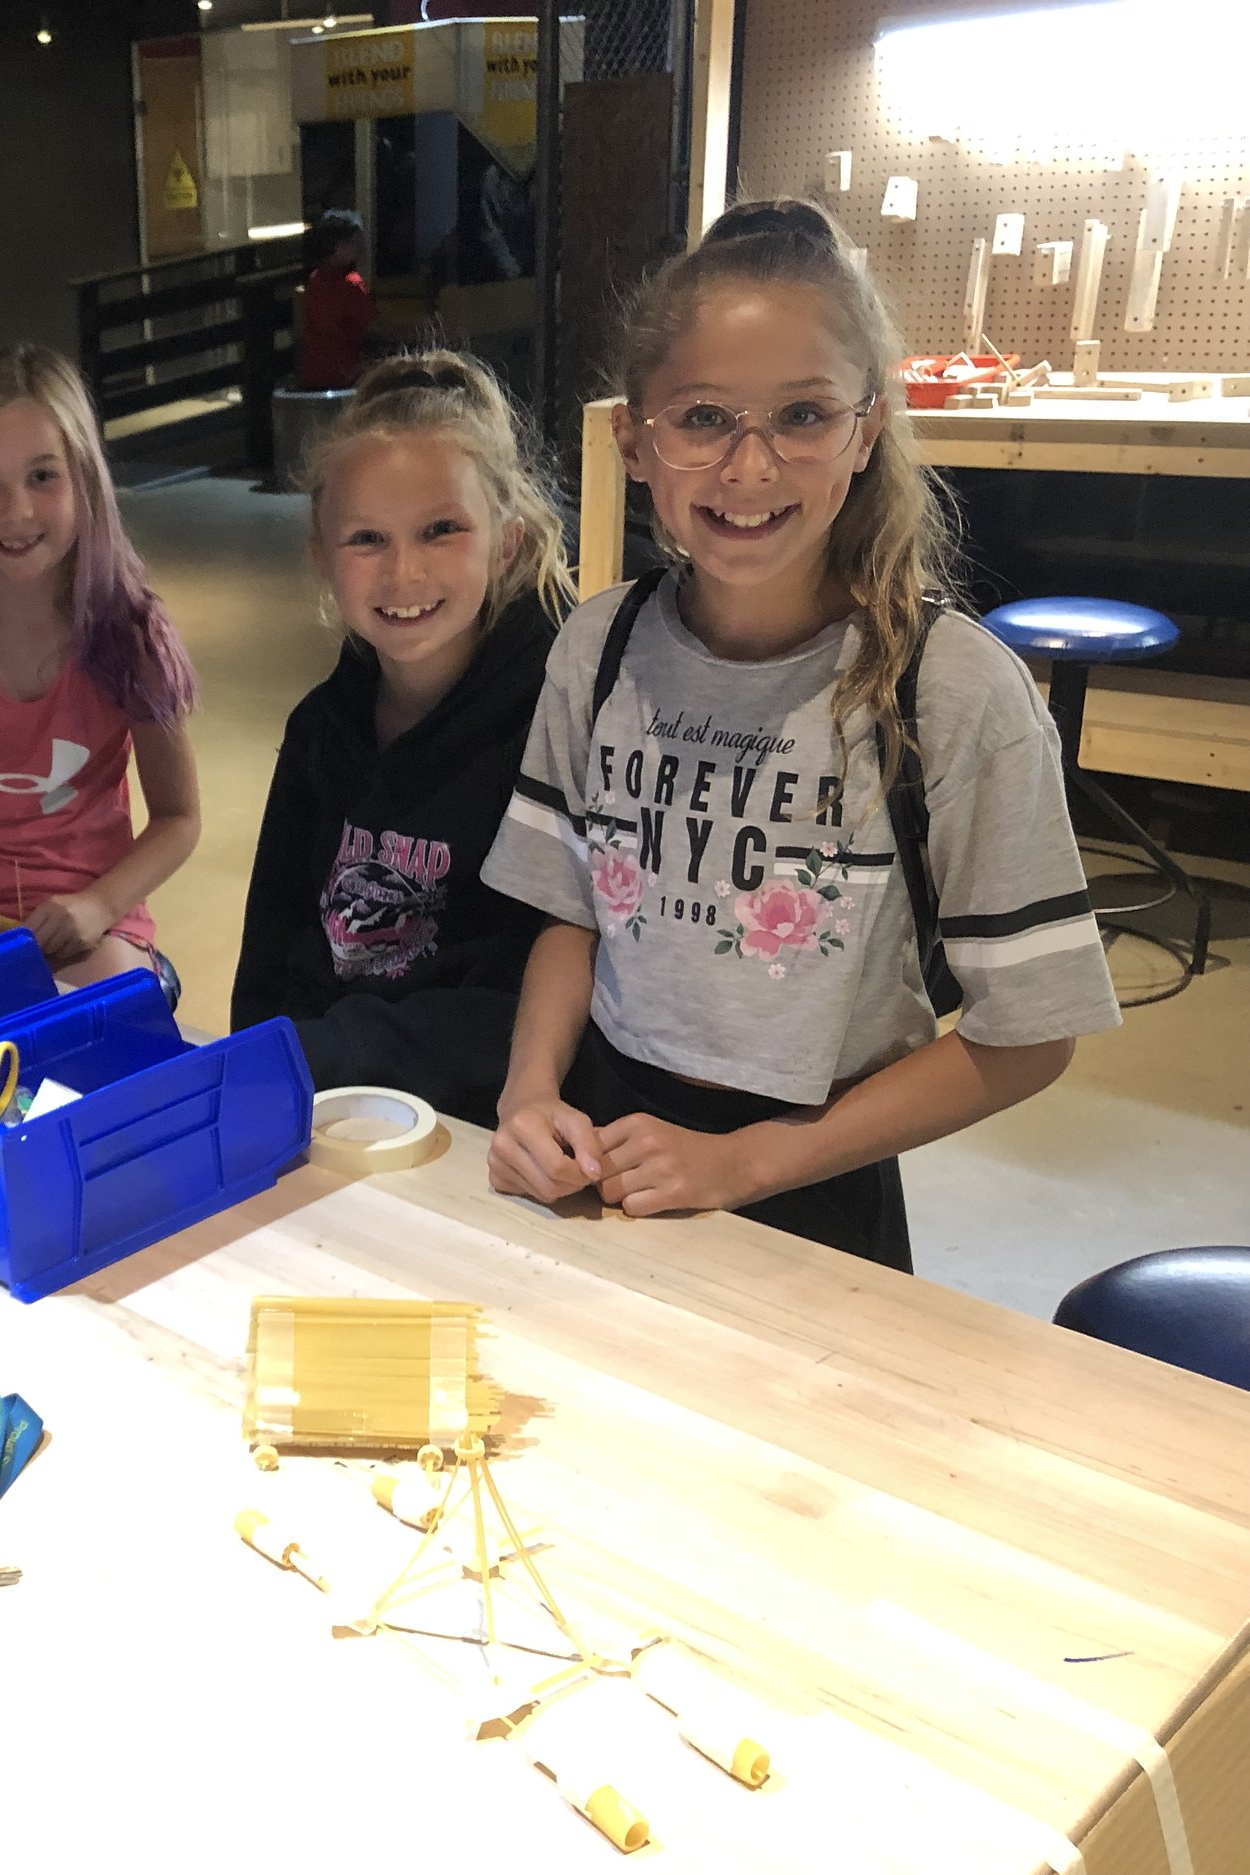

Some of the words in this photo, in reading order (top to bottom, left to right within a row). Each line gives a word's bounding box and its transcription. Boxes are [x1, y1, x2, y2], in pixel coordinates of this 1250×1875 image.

[328, 68, 367, 87] with
[370, 65, 412, 87] your
[523, 60, 537, 78] yo
[646, 707, 681, 740] tout
[683, 715, 710, 744] est
[712, 727, 796, 765] magique
[600, 745, 845, 828] FOREVER
[639, 807, 768, 891] NYC
[659, 896, 717, 926] 1998
